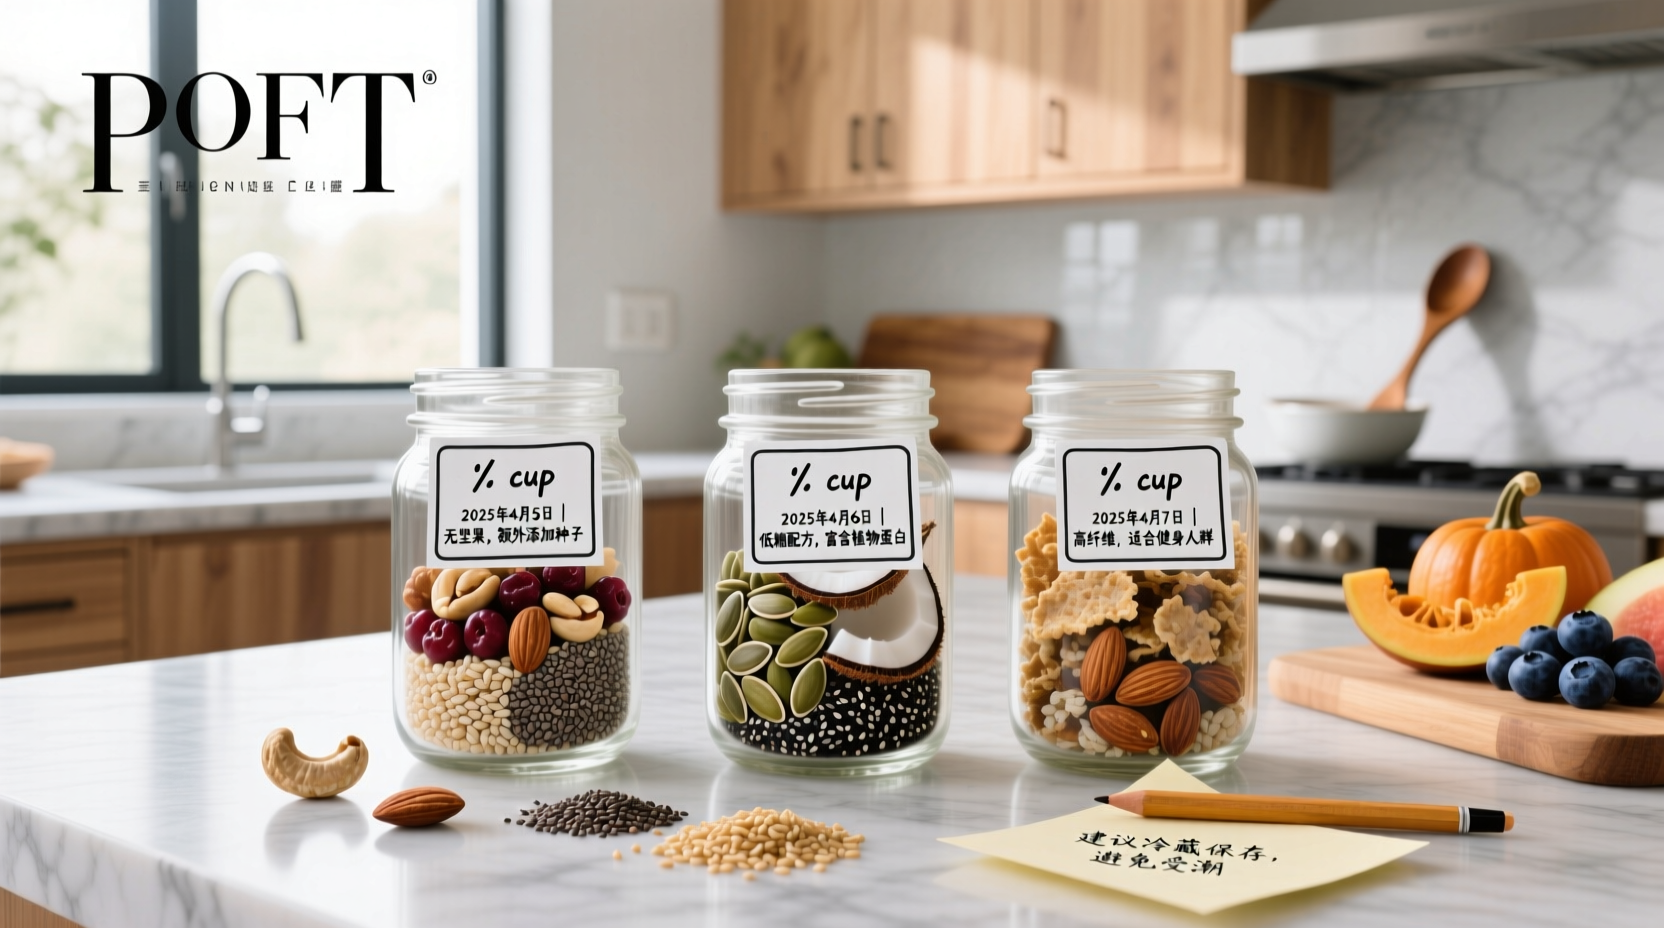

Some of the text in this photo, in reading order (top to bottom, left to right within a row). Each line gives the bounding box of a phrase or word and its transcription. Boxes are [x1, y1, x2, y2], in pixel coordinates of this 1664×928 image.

[509, 469, 556, 498] cup
[826, 472, 872, 502] cup
[1137, 472, 1183, 502] cup
[461, 505, 552, 523] 2025年4月5日
[781, 508, 871, 527] 2025年4月6日
[1092, 508, 1183, 527] 2025年4月7日
